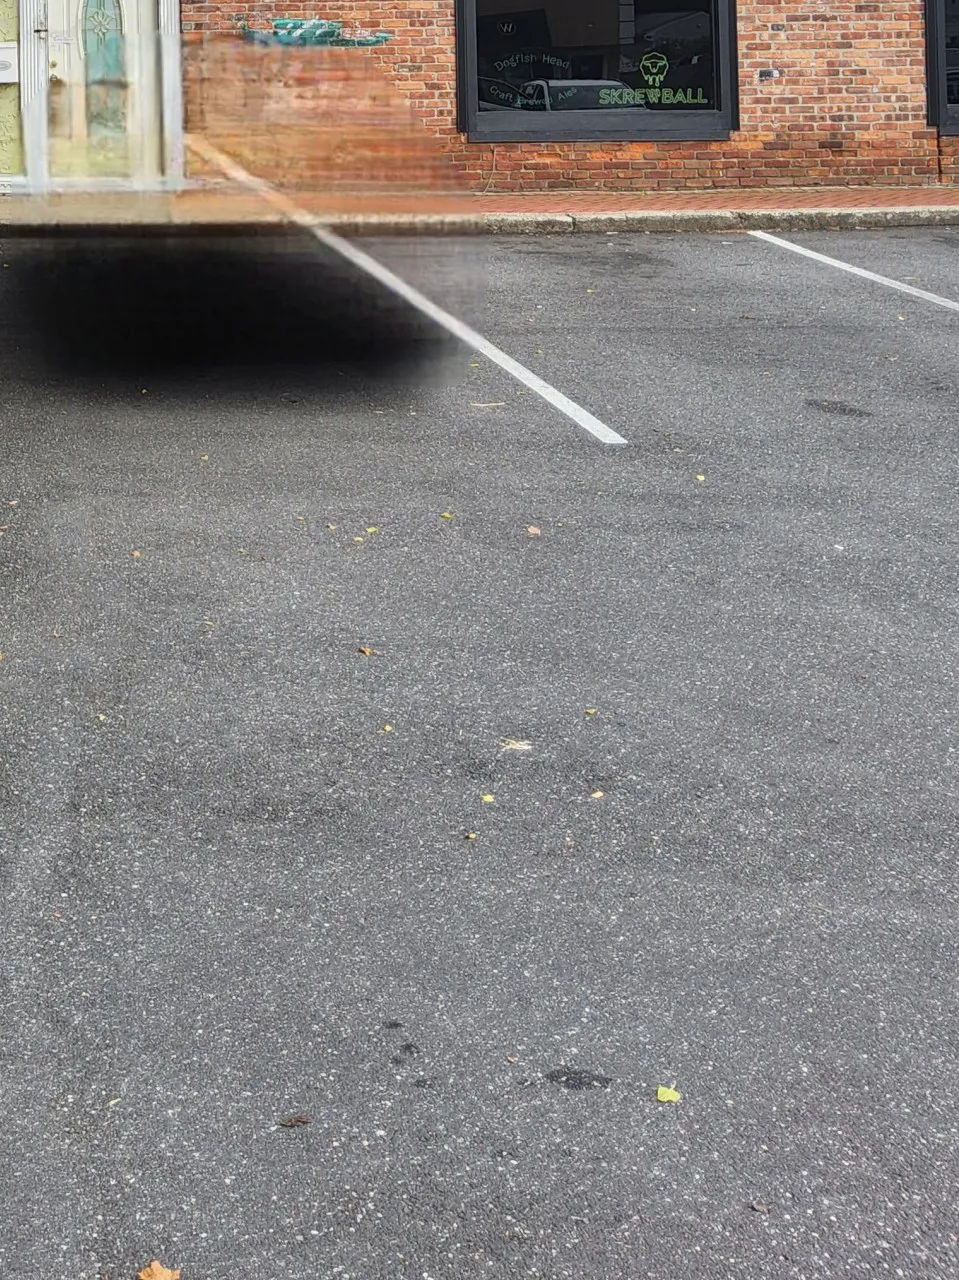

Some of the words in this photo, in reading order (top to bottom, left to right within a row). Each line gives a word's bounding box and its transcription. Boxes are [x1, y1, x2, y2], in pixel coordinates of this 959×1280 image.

[493, 53, 538, 72] Dogfish
[542, 53, 570, 69] Head
[488, 85, 514, 103] Craft
[557, 86, 577, 101] Ales
[598, 87, 709, 105] SKREWBALL
